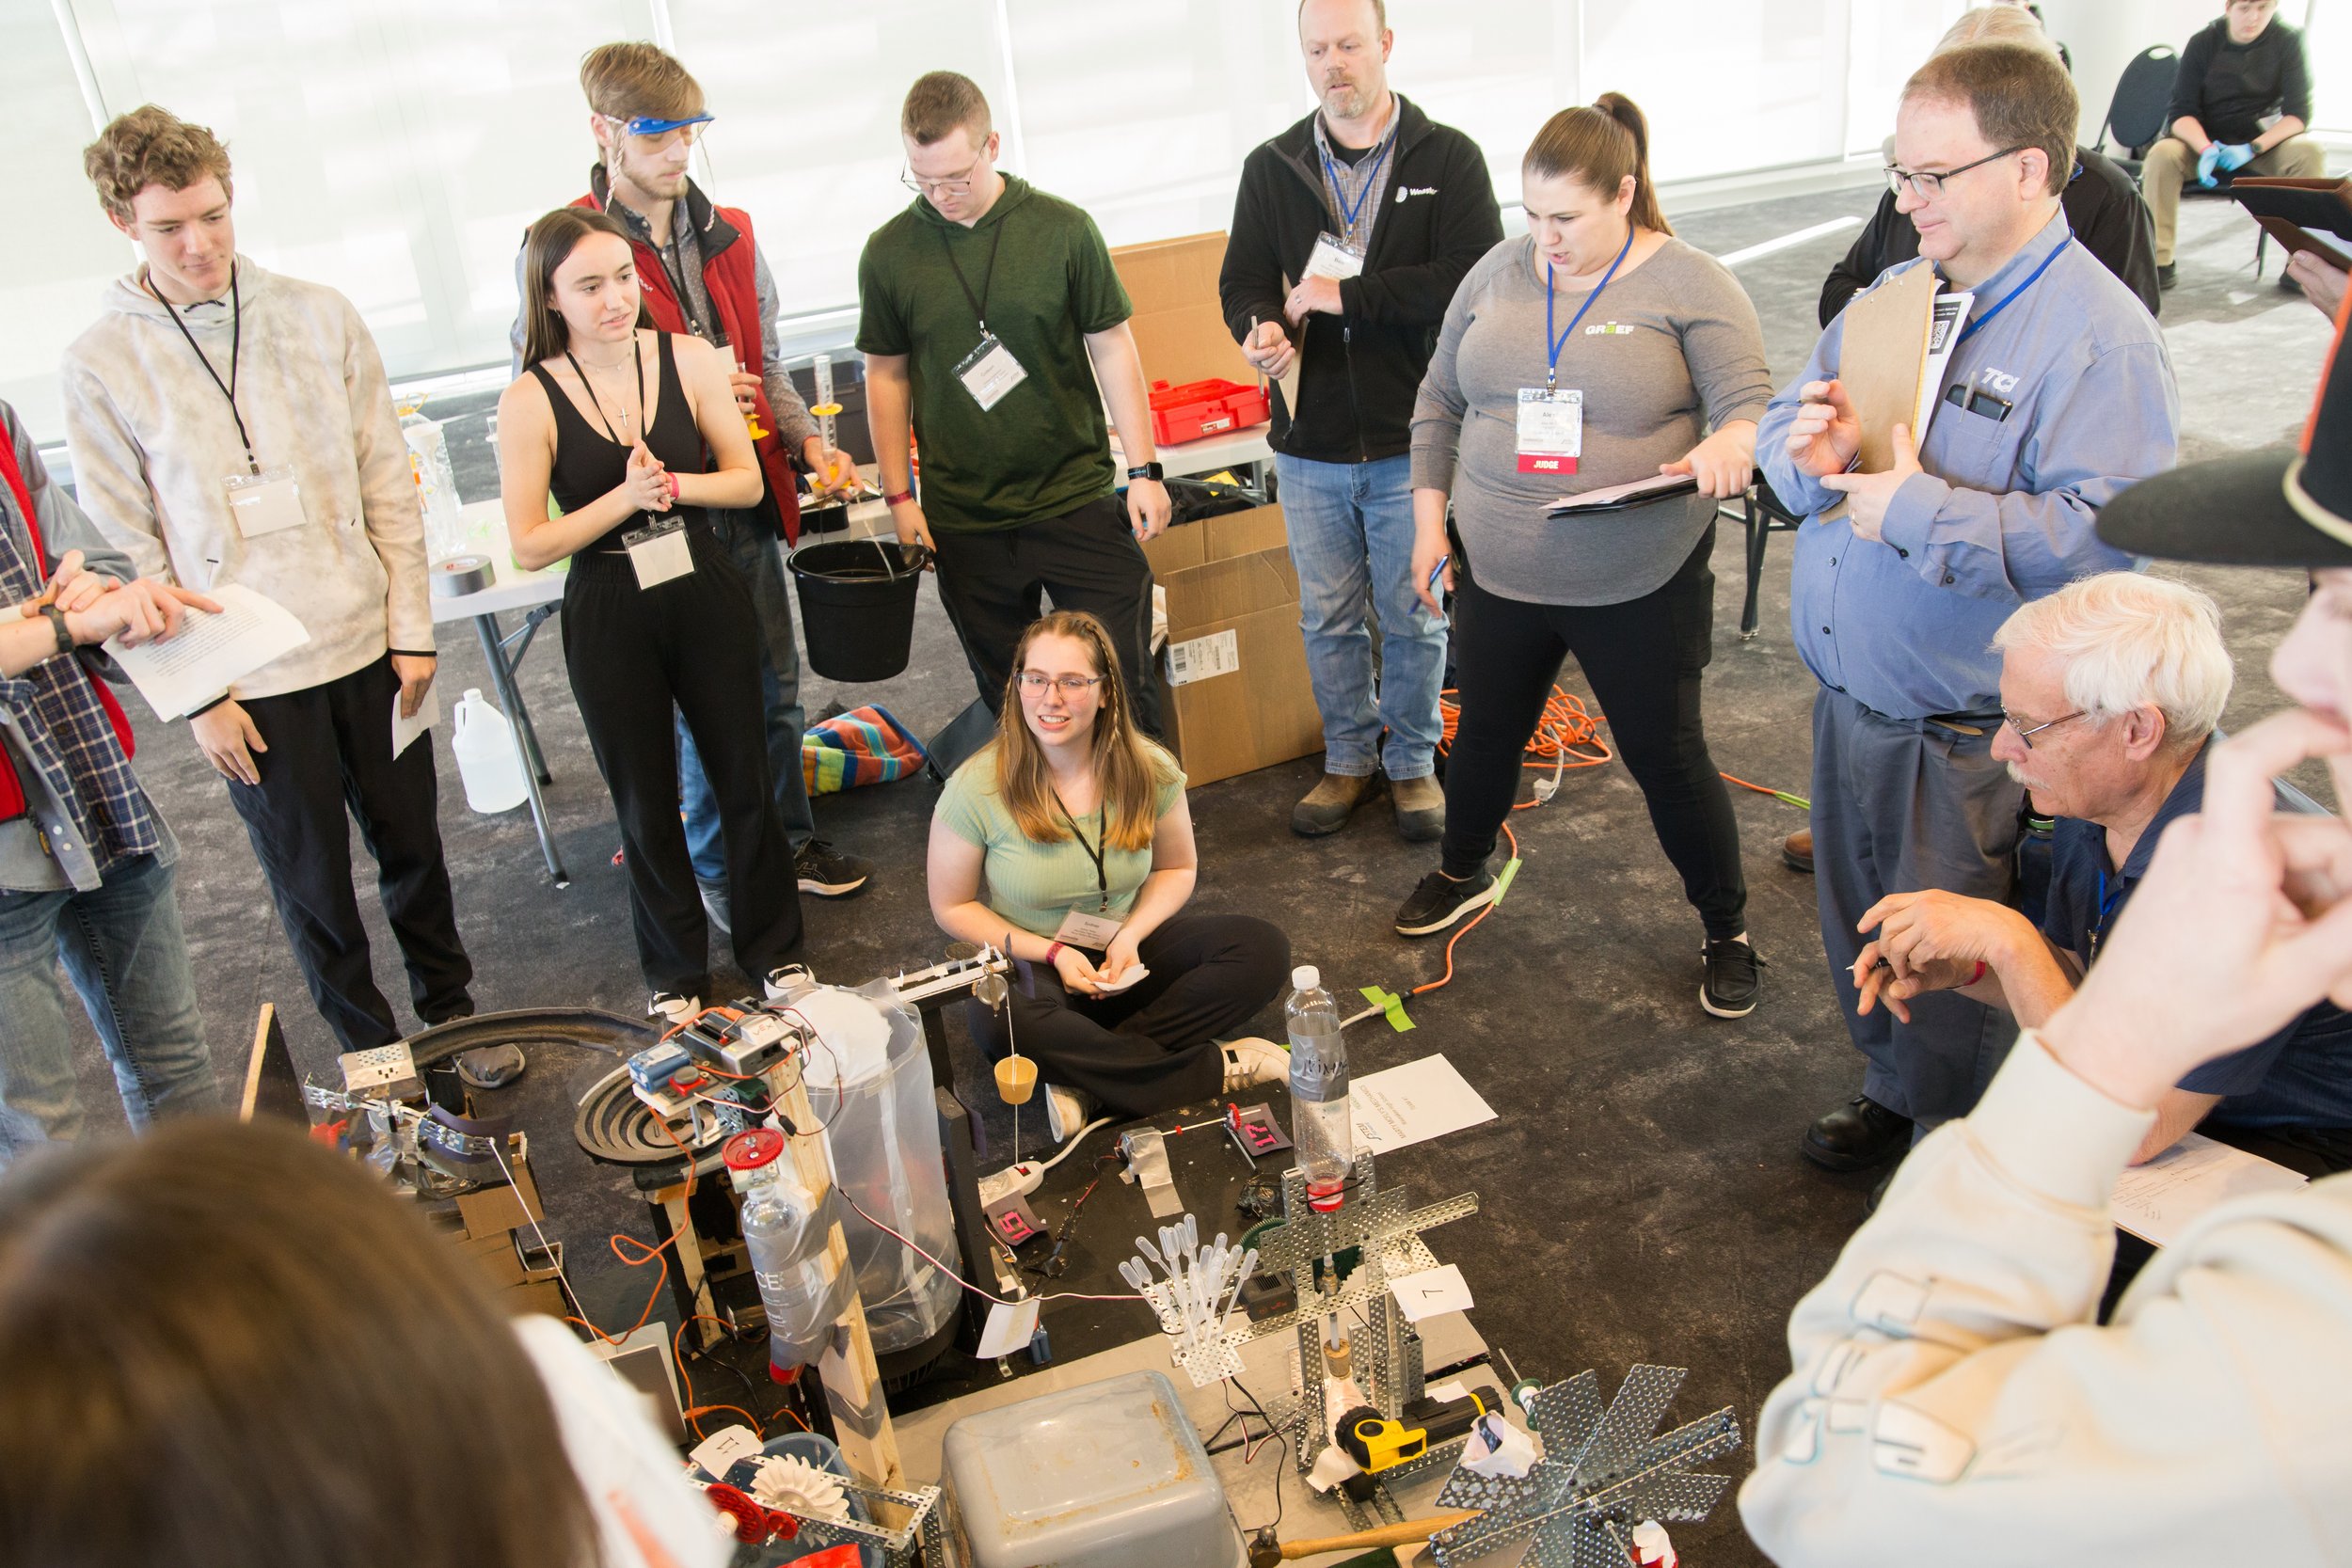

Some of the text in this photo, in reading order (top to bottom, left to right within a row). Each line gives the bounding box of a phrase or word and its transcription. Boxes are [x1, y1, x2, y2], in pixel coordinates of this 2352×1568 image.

[1981, 367, 2020, 392] TCI
[1534, 460, 1560, 469] JUDGE
[753, 1023, 775, 1036] VEX
[1245, 1122, 1279, 1147] 17
[998, 1210, 1035, 1240] 15
